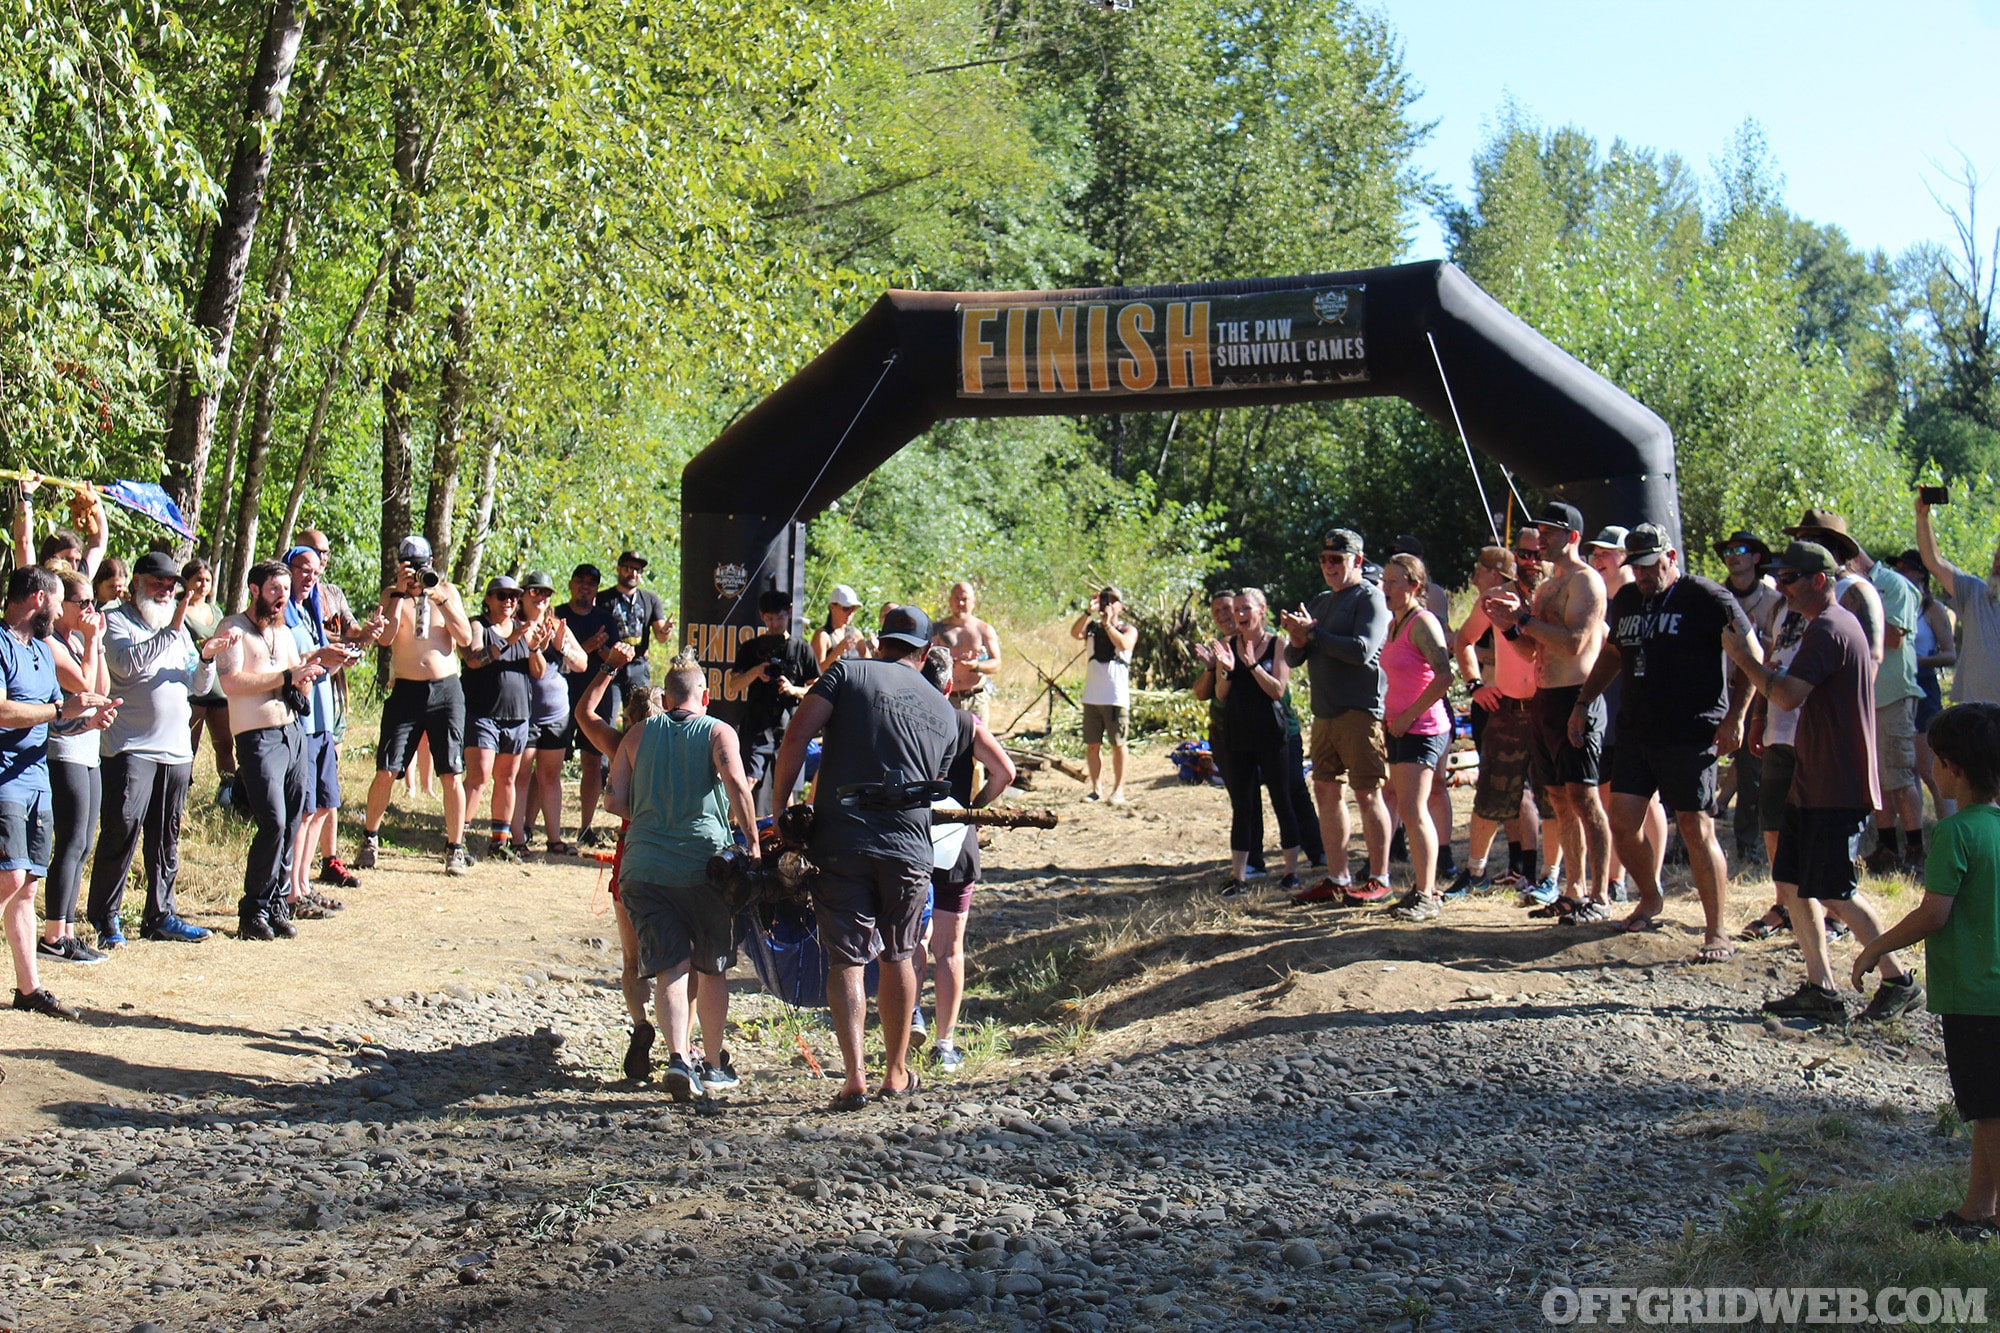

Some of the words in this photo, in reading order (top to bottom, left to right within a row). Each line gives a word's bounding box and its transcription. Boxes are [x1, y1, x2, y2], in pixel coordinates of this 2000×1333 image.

[962, 301, 1213, 394] FINISH
[1216, 321, 1249, 343] THE
[1255, 319, 1292, 341] PNW
[1216, 341, 1301, 367] SURVIVAL
[1306, 337, 1365, 362] GAMES
[688, 623, 769, 663] FINI
